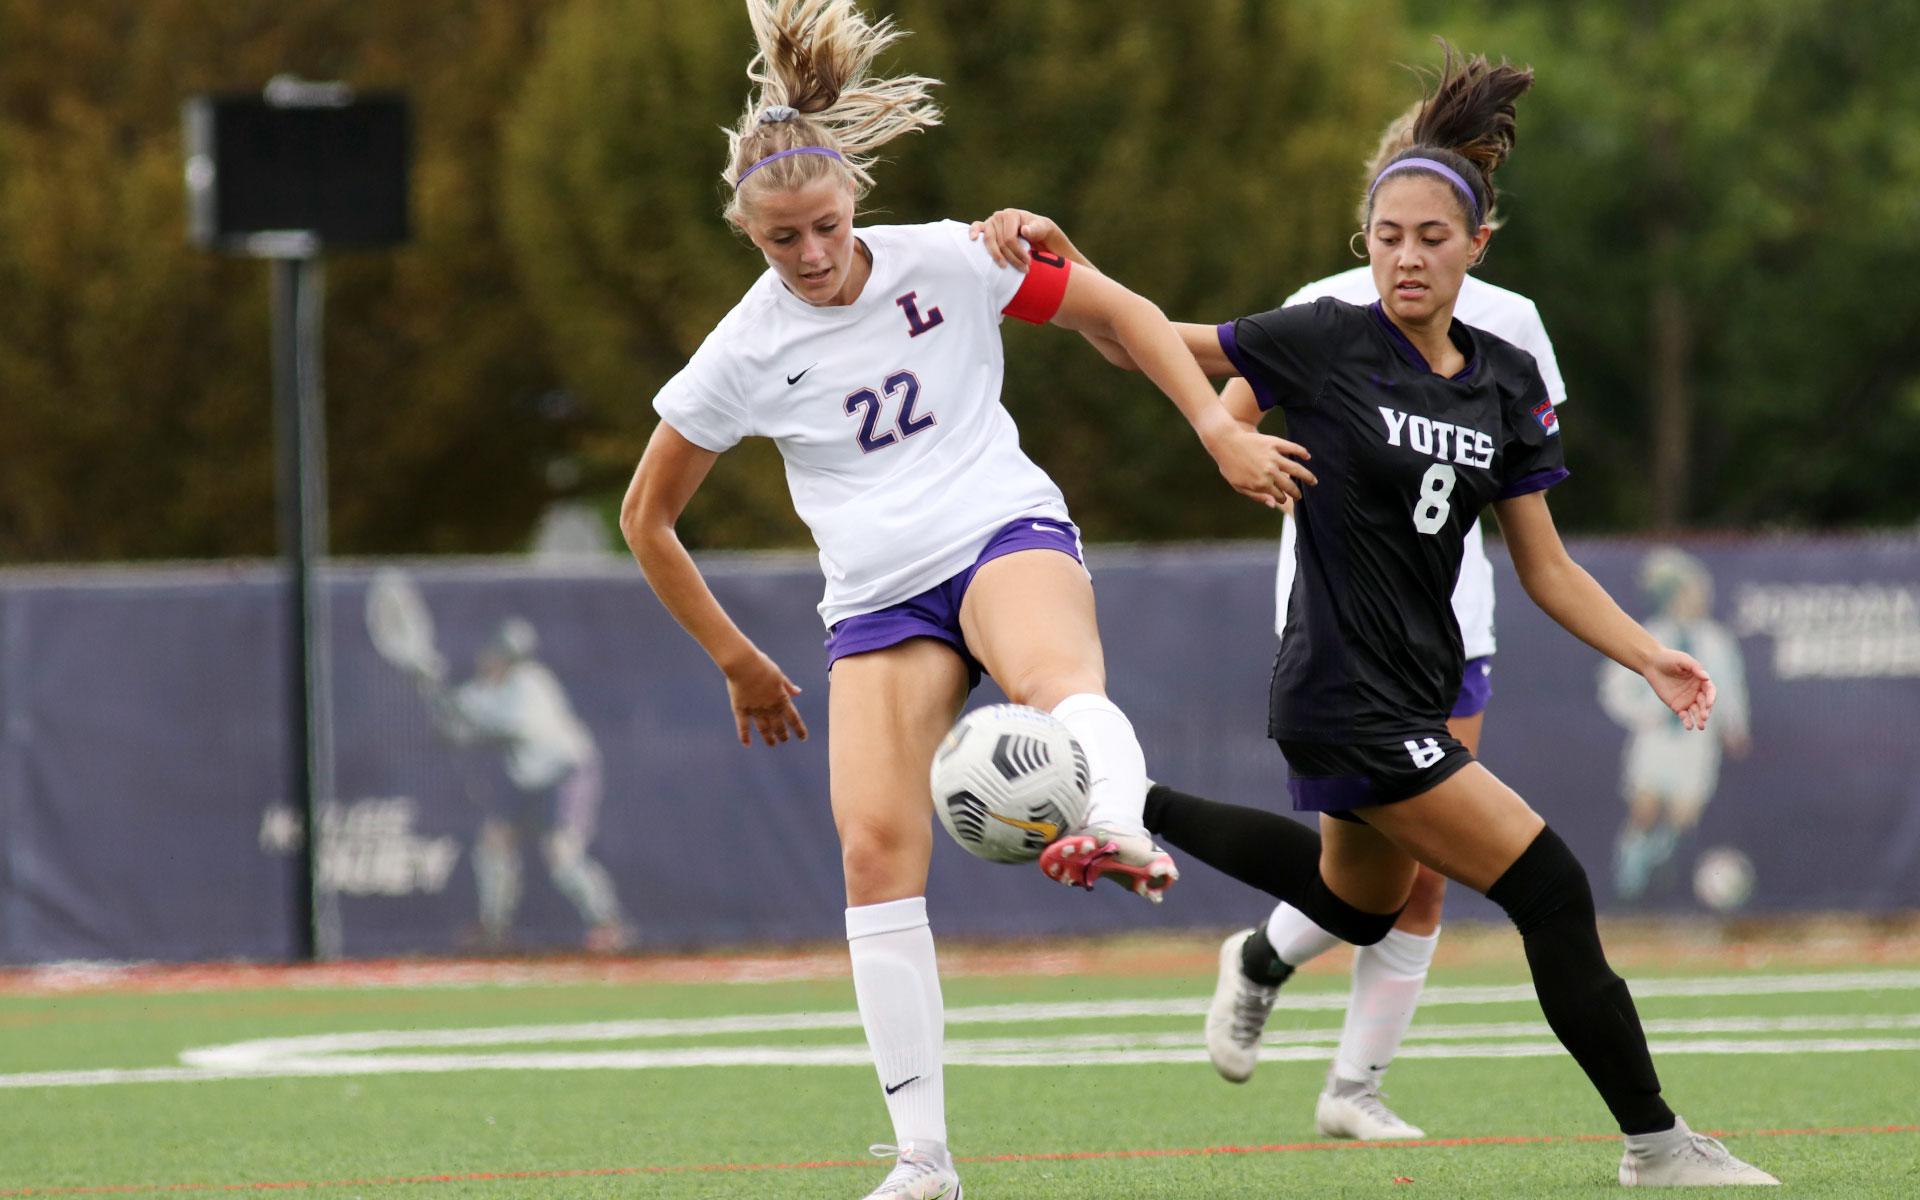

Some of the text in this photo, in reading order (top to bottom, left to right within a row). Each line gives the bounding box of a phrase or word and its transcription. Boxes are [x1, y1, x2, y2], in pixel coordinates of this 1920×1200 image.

[896, 291, 944, 338] L
[843, 369, 938, 455] 22
[1378, 405, 1496, 470] YOTES
[1413, 463, 1456, 535] 8
